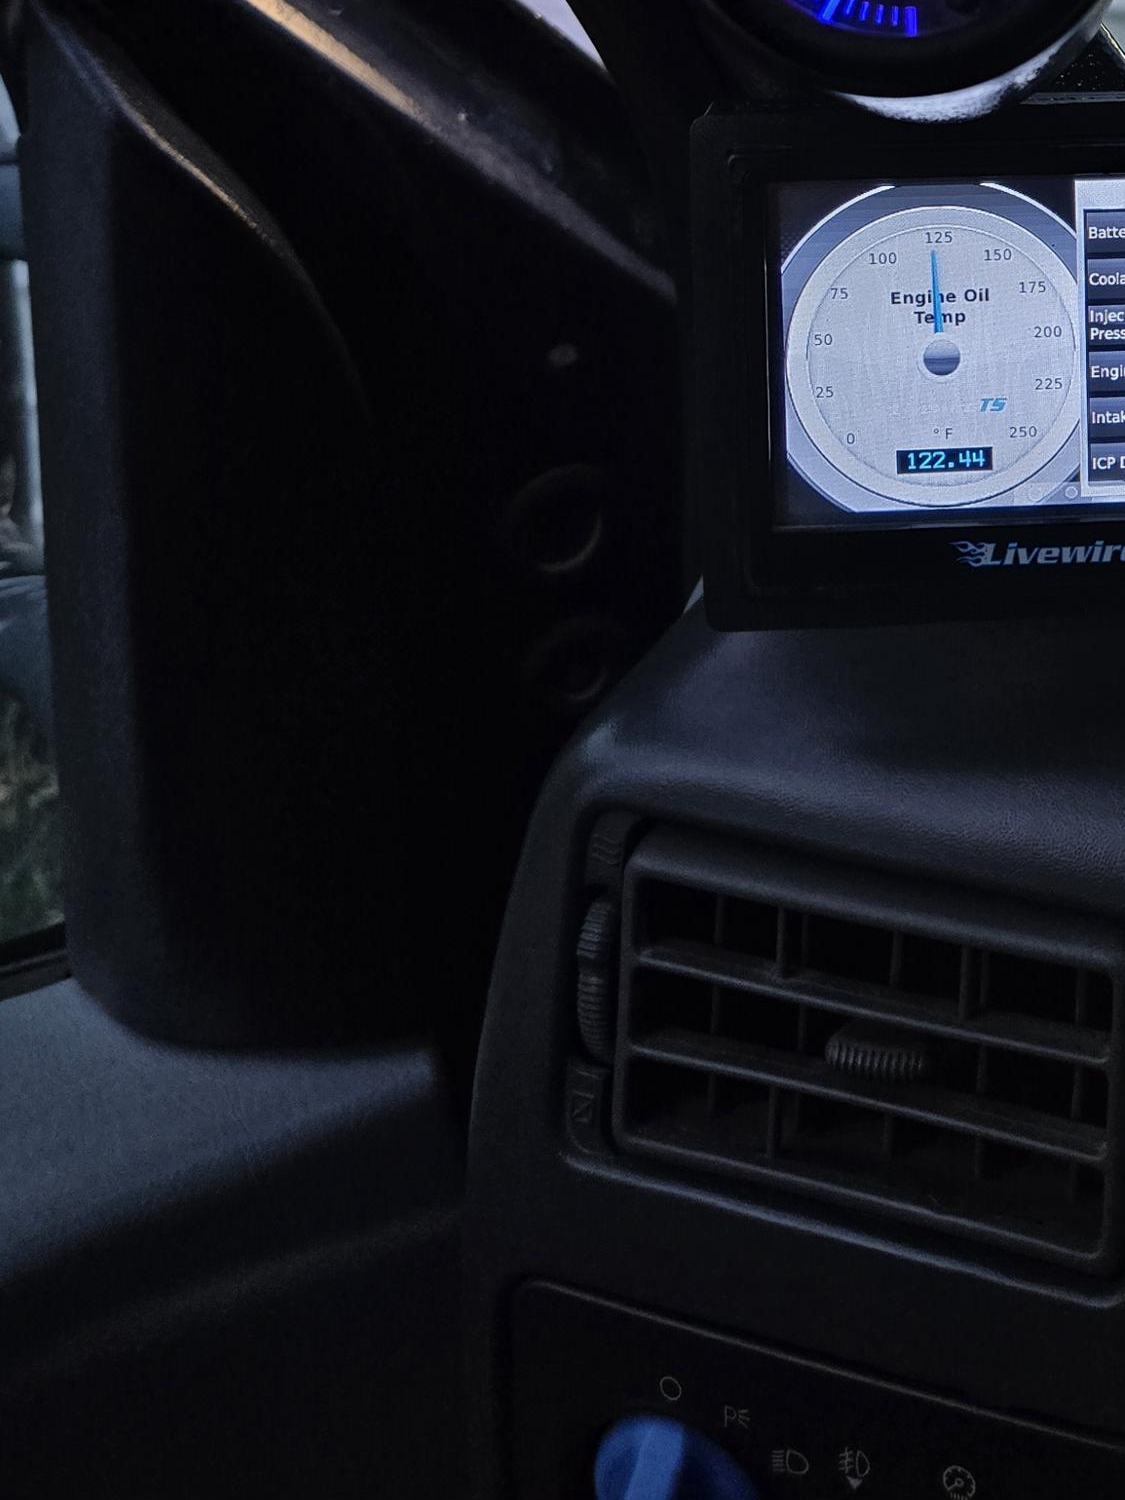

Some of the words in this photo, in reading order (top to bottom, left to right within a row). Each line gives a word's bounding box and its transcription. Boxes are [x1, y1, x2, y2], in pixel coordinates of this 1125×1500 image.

[925, 231, 953, 245] 125
[869, 252, 897, 265] 100
[984, 249, 1012, 262] 150
[830, 287, 849, 300] 75
[1018, 281, 1046, 295] 175
[890, 289, 957, 308] Engine
[964, 287, 990, 303] Oil
[914, 310, 966, 327] Temp
[1034, 325, 1062, 338] 200
[814, 333, 833, 346] 50
[1035, 377, 1063, 391] 225
[815, 386, 834, 399] 25
[979, 397, 1007, 412] TS
[846, 432, 856, 445] 0
[1009, 425, 1037, 439] 250
[907, 450, 985, 471] 122.44
[1092, 456, 1116, 470] ICP
